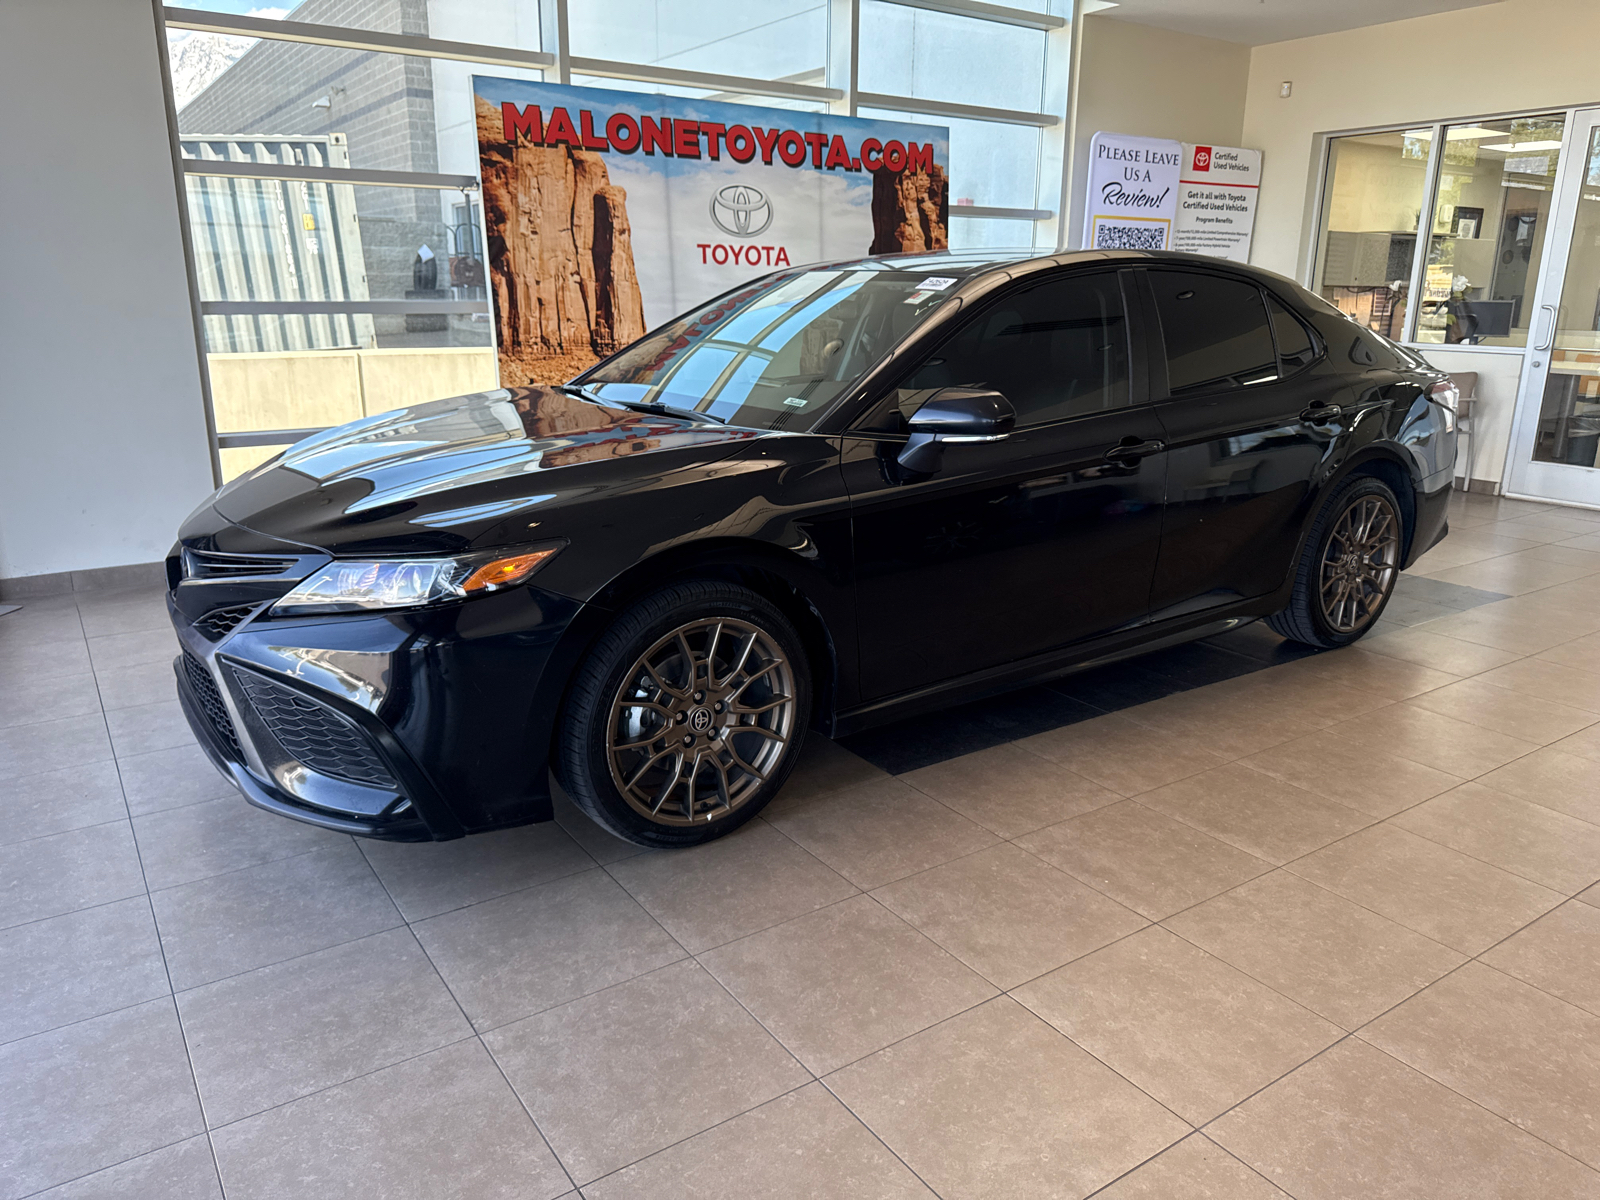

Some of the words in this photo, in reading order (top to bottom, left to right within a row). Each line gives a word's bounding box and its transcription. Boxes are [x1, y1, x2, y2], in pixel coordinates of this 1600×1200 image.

[501, 102, 935, 174] MALONETOYOTA.COM
[1098, 144, 1140, 162] PLEASE
[1145, 150, 1179, 166] LEAVE
[1215, 152, 1238, 161] Certified
[1214, 162, 1227, 170] Used
[1228, 163, 1249, 172] Vehicles
[1143, 170, 1152, 182] A
[1102, 182, 1170, 208] Review!
[1188, 191, 1199, 199] Get
[1205, 192, 1213, 200] all
[1214, 192, 1227, 201] with
[1228, 194, 1246, 202] Toyota
[1183, 202, 1208, 210] Certified
[1209, 203, 1224, 211] Used
[1225, 203, 1248, 212] Vehicles
[1196, 216, 1214, 225] Program
[1215, 217, 1233, 225] Benefits
[697, 243, 790, 267] TOYOTA
